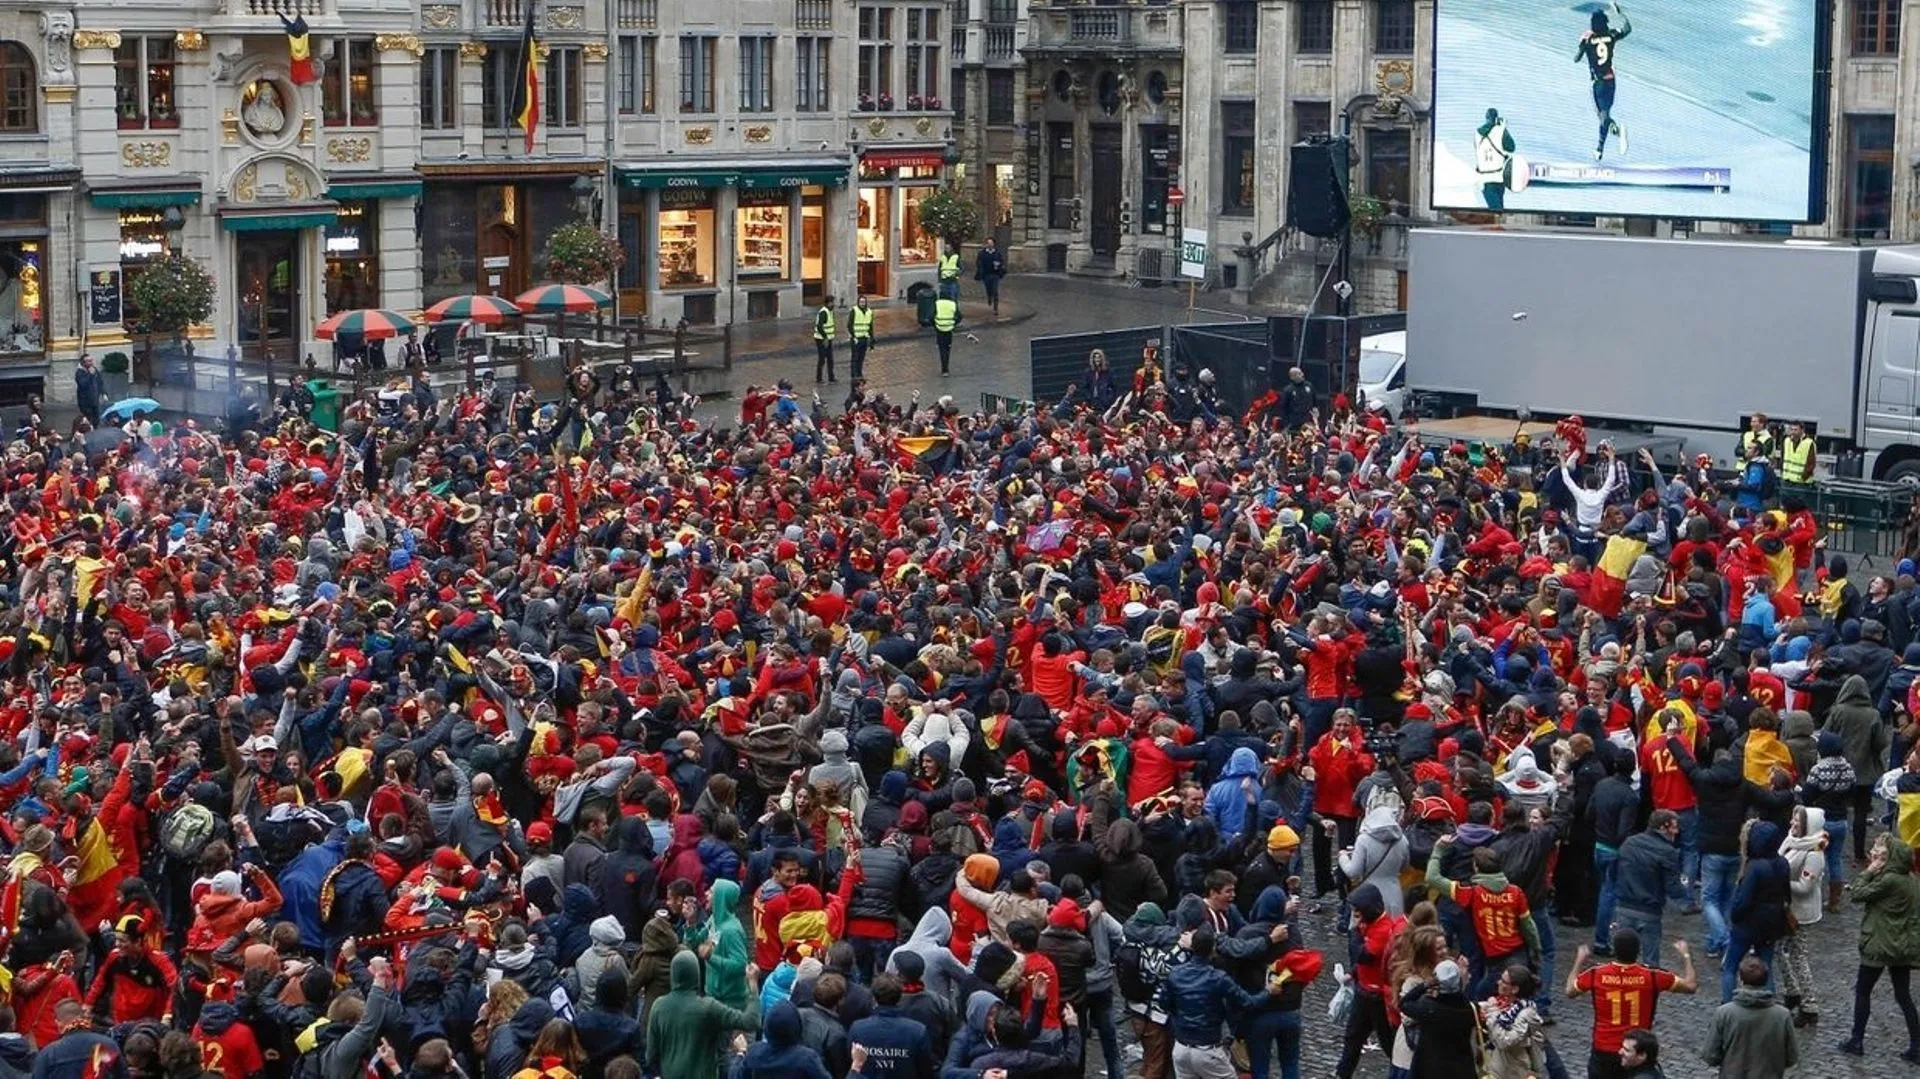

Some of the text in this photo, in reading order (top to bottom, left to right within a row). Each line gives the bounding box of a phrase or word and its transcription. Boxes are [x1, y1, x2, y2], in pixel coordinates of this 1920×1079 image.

[1596, 42, 1609, 66] 9
[667, 177, 700, 187] GODIVA
[780, 177, 810, 187] GODIVA
[663, 189, 707, 203] GODIVA
[1652, 748, 1678, 773] 12
[1480, 891, 1514, 904] VINCE
[1479, 907, 1517, 940] 10
[1606, 990, 1641, 1027] 11
[197, 1041, 225, 1073] 12
